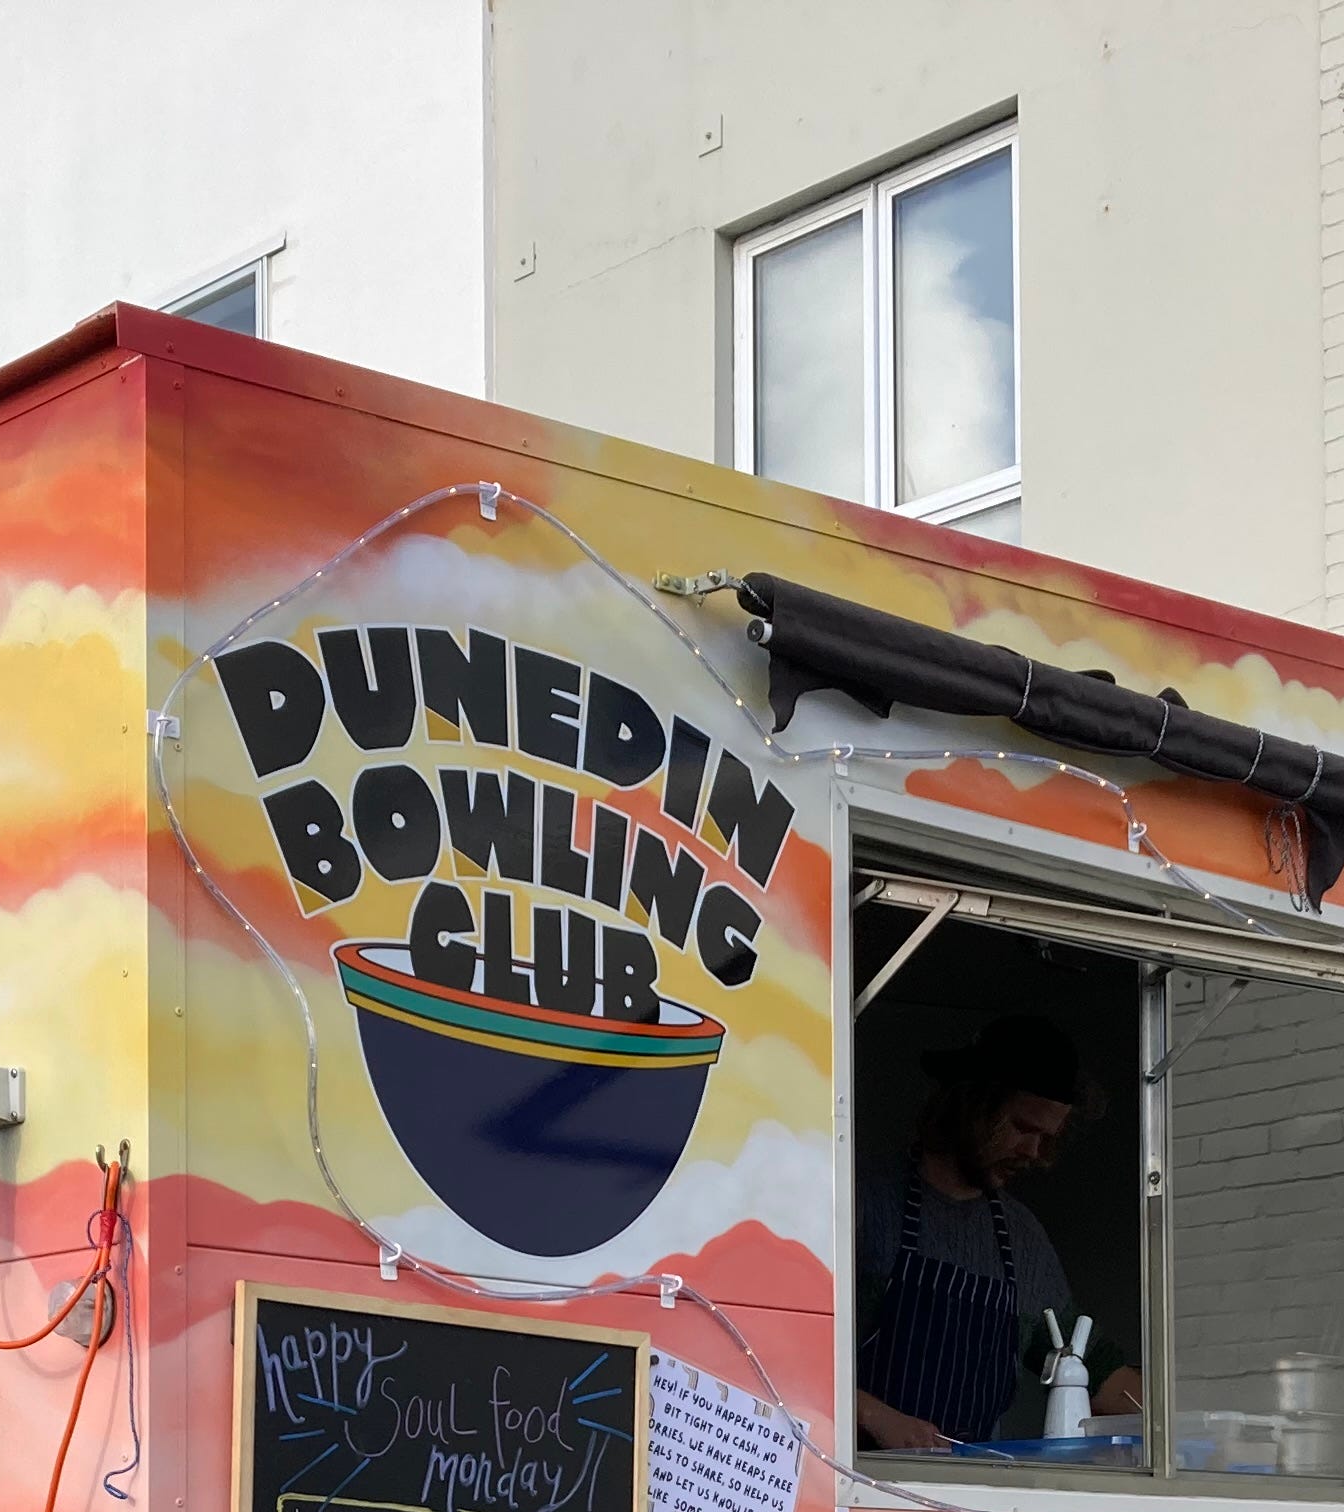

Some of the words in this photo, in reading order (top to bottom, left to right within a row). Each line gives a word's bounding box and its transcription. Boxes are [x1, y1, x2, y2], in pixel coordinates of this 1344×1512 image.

[211, 625, 795, 891] DUNEDIN
[260, 763, 762, 988] BOWLING
[408, 880, 661, 1024] CLUB
[257, 1321, 407, 1424] happy
[489, 1366, 574, 1470] food
[654, 1375, 678, 1397] HEY!
[678, 1387, 690, 1400] IF
[692, 1394, 713, 1412] YOU
[715, 1406, 754, 1432] HAPPEN
[758, 1424, 770, 1439] TO
[772, 1431, 786, 1447] BE
[786, 1440, 795, 1452] A
[664, 1402, 681, 1419] BIT
[685, 1412, 713, 1435] TIGHT
[716, 1428, 730, 1444] ON
[763, 1450, 777, 1464] NO
[647, 1486, 668, 1504] LIKE
[653, 1467, 673, 1483] AND
[676, 1476, 694, 1493] LET
[697, 1485, 710, 1500] US
[676, 1452, 689, 1467] TO
[728, 1477, 742, 1492] SO
[744, 1485, 768, 1504] HELP
[772, 1497, 784, 1512] US
[689, 1437, 704, 1453] WE
[706, 1444, 731, 1465] HAVE
[734, 1458, 766, 1482] HEAPS
[768, 1473, 793, 1493] FREE
